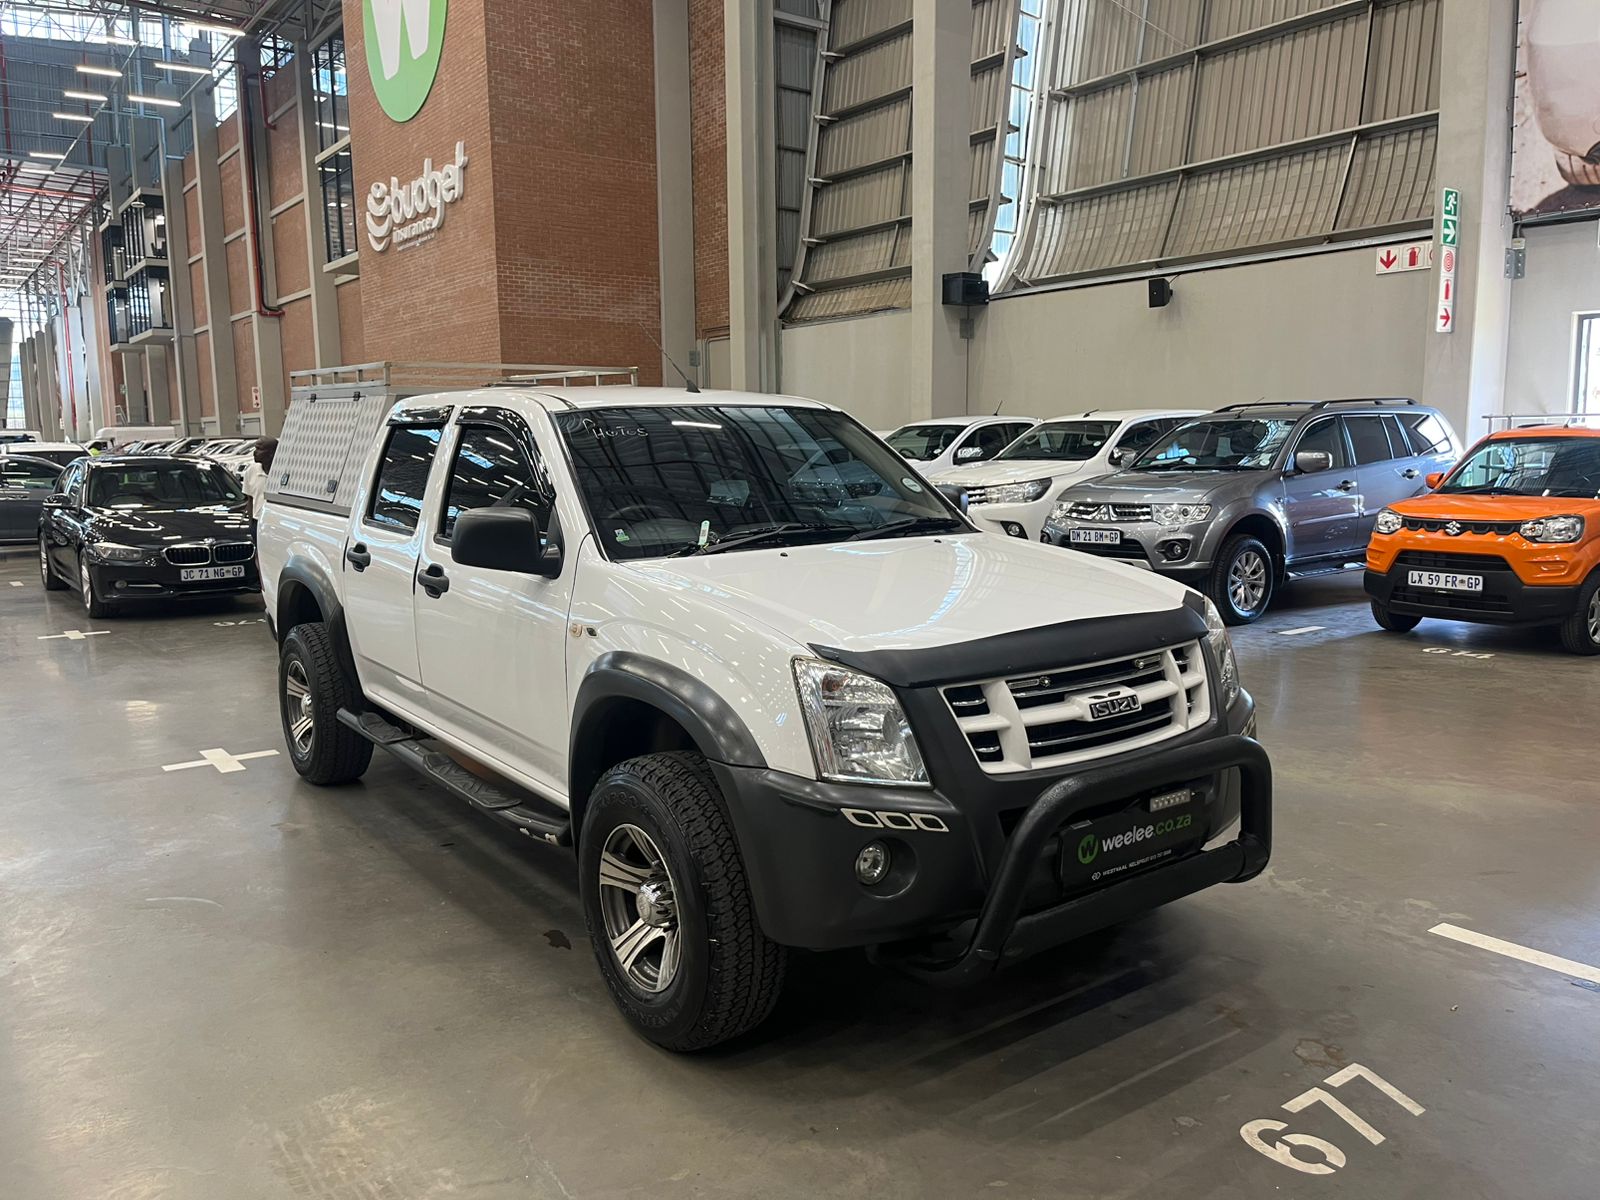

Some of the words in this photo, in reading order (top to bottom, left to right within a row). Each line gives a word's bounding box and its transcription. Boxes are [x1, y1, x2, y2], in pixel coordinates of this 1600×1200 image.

[391, 141, 469, 230] budget
[1083, 531, 1092, 542] 21
[1094, 531, 1104, 542] BM
[1109, 532, 1119, 543] GP
[183, 569, 195, 580] JC
[198, 569, 210, 579] 71
[213, 568, 225, 578] NG
[231, 566, 243, 577] GP
[1410, 572, 1424, 585] LX
[1427, 573, 1441, 586] 59
[1444, 575, 1458, 588] FR
[1467, 576, 1481, 589] GP
[1091, 696, 1140, 718] ISUZU
[1102, 814, 1192, 852] weelee.co.za
[1239, 1062, 1427, 1175] 677
